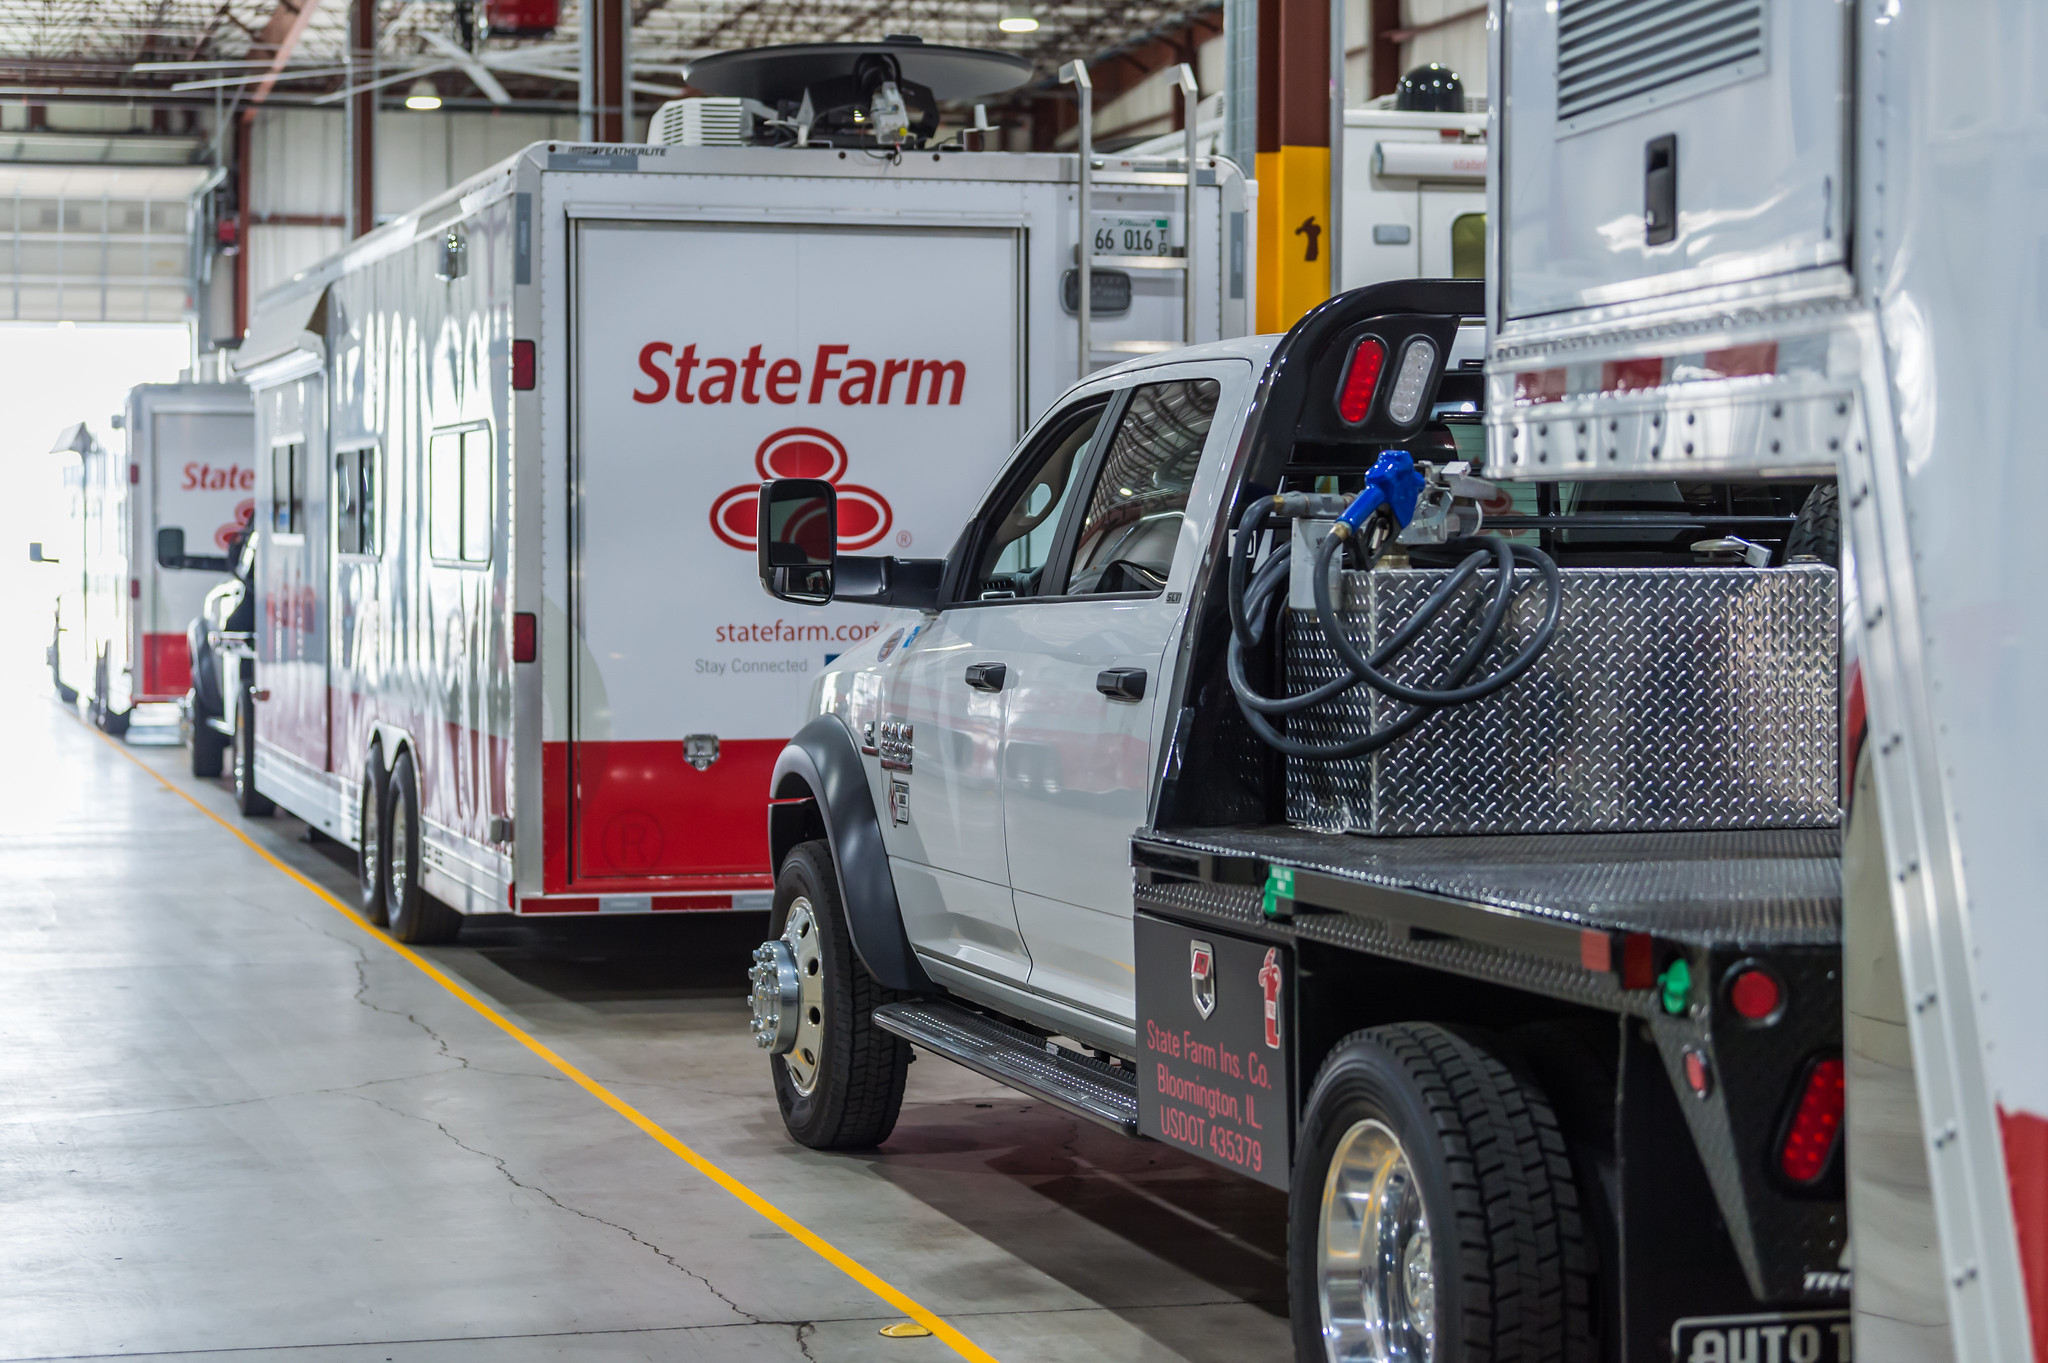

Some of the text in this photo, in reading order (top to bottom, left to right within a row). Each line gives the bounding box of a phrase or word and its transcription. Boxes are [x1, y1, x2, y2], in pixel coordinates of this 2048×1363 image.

[598, 145, 667, 157] FEATHERLITE
[1095, 228, 1153, 250] 66 016
[633, 341, 966, 406] State Farm
[694, 657, 808, 676] Stay Connected
[1147, 1019, 1272, 1090] State Farm Ins. Co.
[1157, 1063, 1242, 1126] Bloomington,
[1160, 1104, 1262, 1173] USDOT 435379
